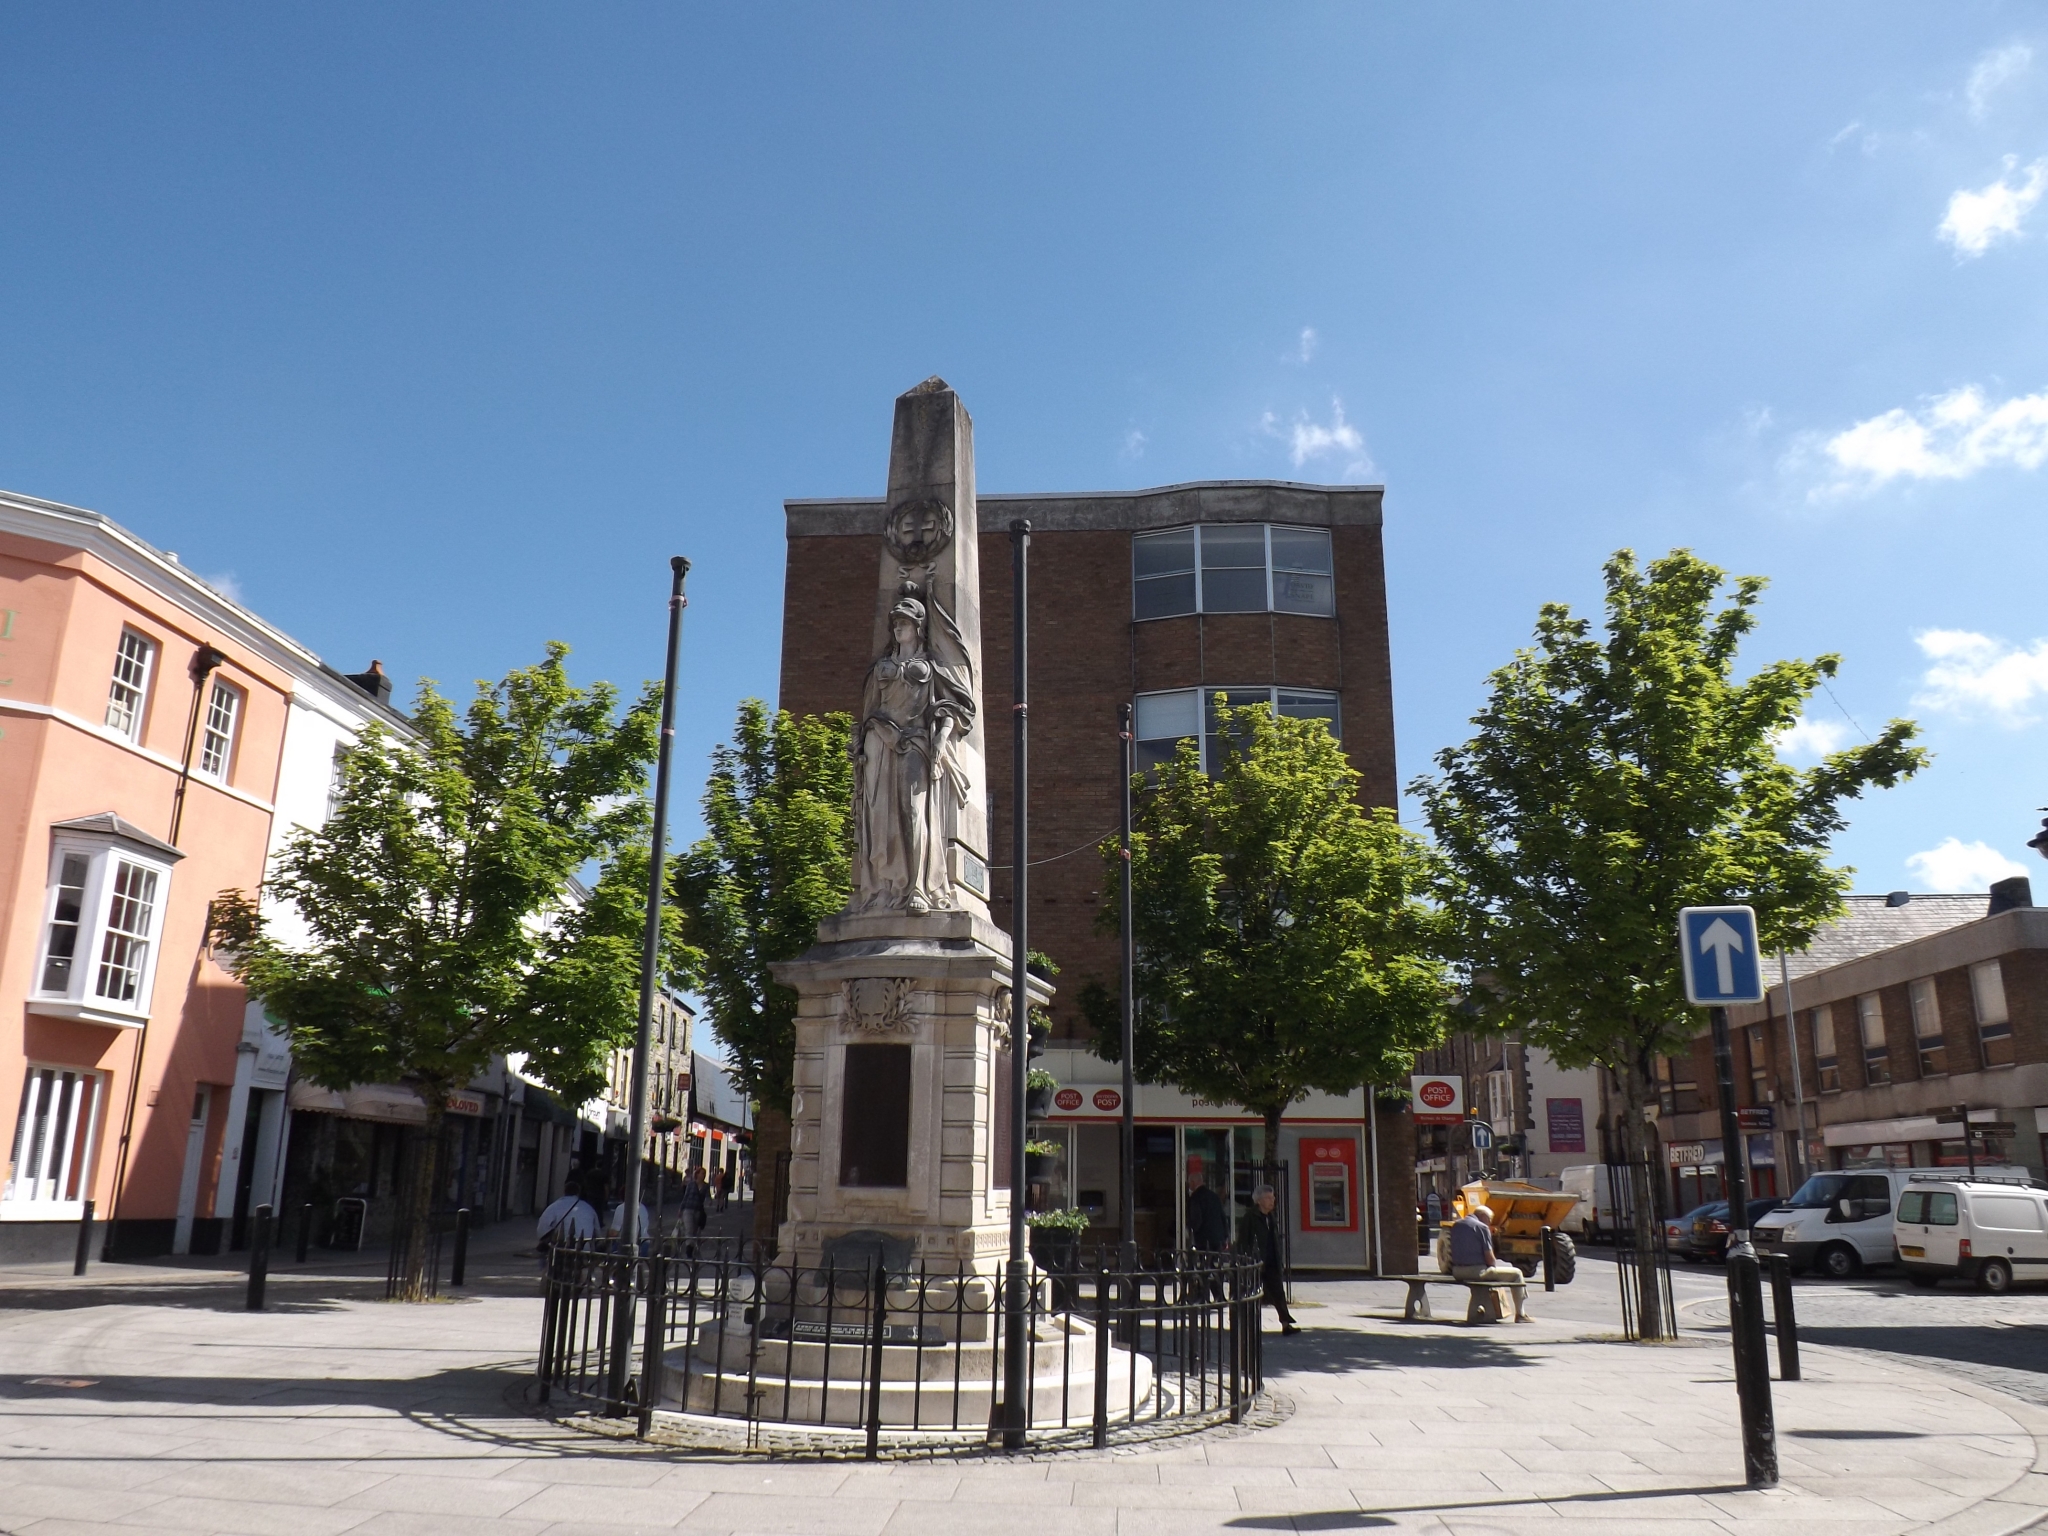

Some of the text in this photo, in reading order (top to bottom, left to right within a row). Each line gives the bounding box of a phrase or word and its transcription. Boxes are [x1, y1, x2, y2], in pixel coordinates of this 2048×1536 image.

[1427, 1086, 1448, 1094] POST
[1423, 1094, 1451, 1102] OFFICE
[1097, 1099, 1117, 1107] POST
[1670, 1144, 1705, 1163] BETFRED
